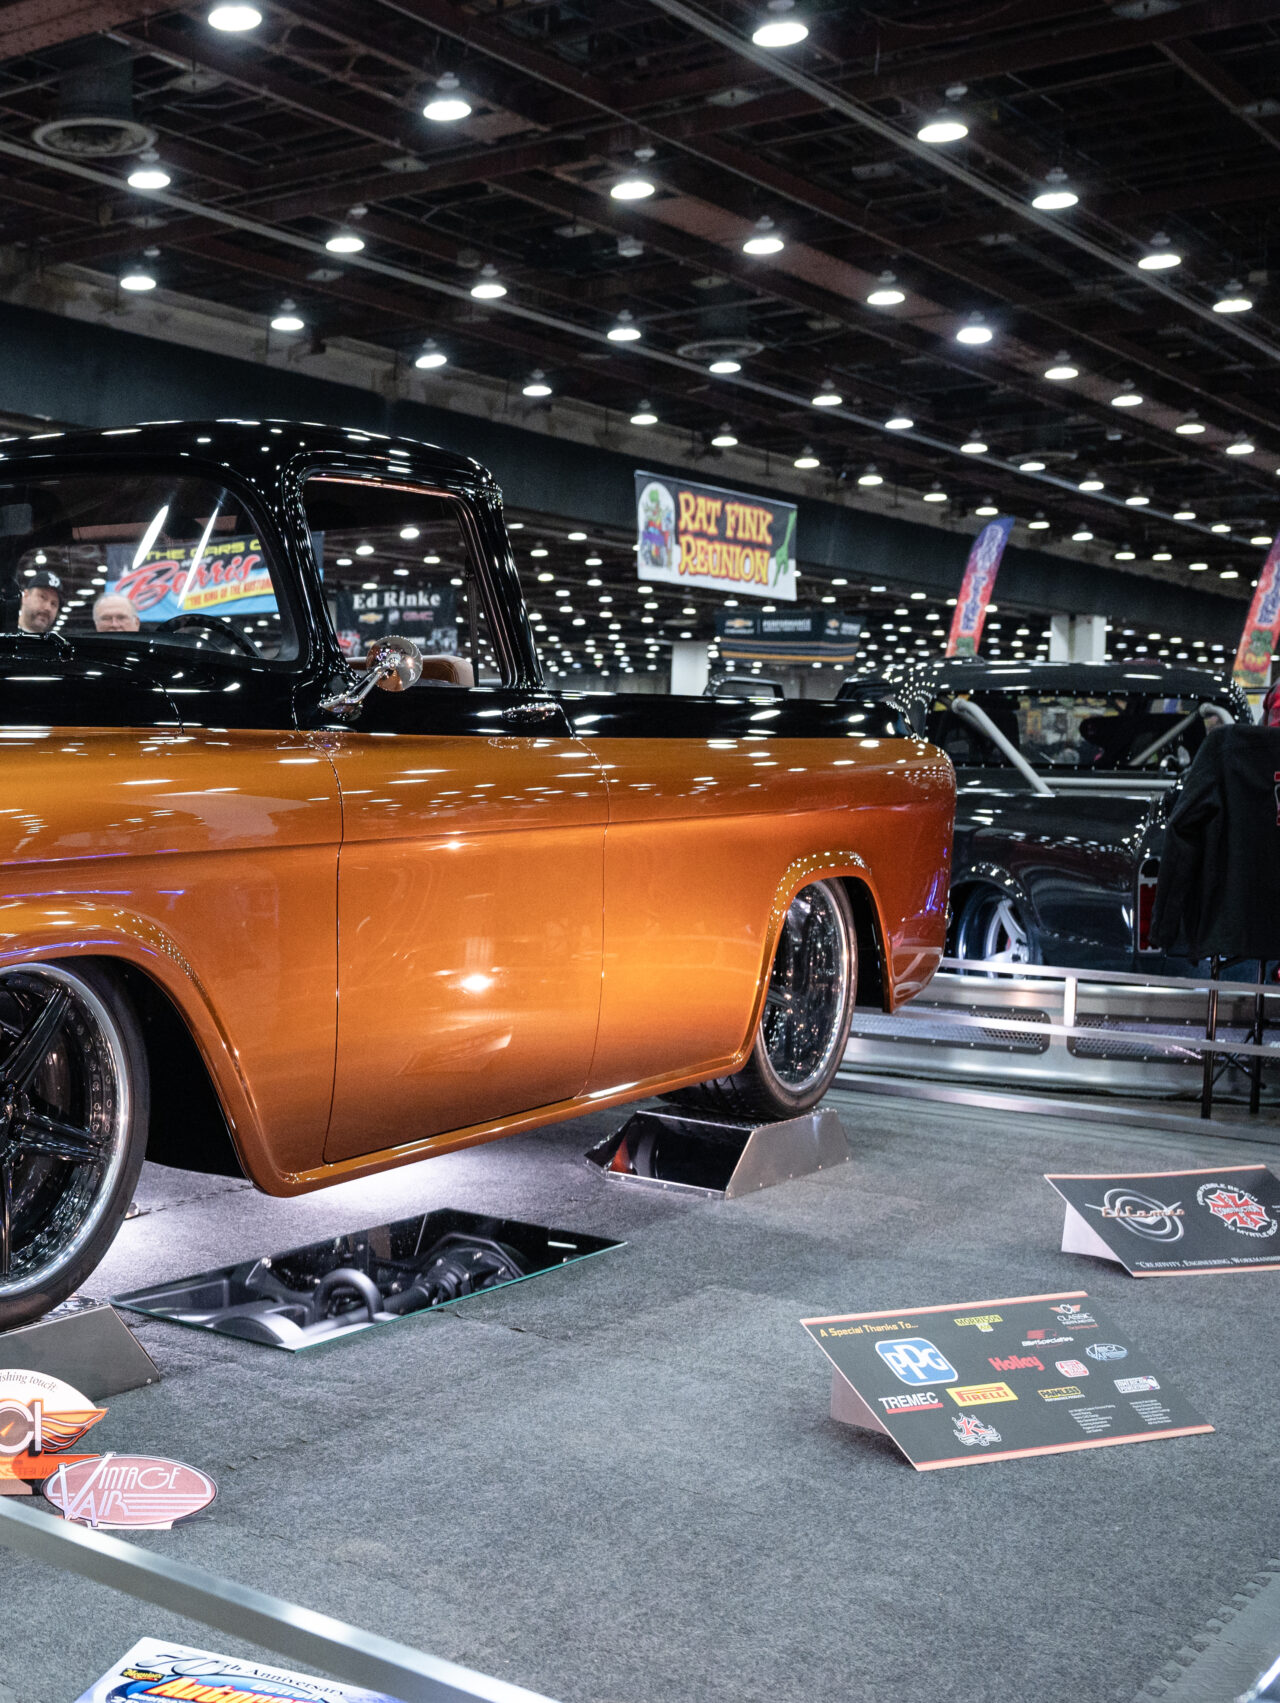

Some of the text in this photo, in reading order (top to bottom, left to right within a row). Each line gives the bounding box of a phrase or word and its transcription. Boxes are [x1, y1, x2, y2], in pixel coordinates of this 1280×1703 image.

[678, 491, 773, 545] RAT FINK
[678, 533, 770, 585] REUNION
[353, 591, 441, 610] Ed Rinke
[820, 1329, 828, 1337] A
[828, 1326, 864, 1337] Special
[863, 1324, 899, 1333] Thanks
[956, 1315, 1002, 1326] MORRISON
[884, 1345, 949, 1379] PPG
[987, 1354, 1045, 1371] Holley
[878, 1392, 939, 1409] TREMEC
[954, 1386, 1010, 1403] PIRELLI
[58, 1451, 182, 1519] VINTAGE
[77, 1490, 129, 1527] AIR
[248, 1668, 345, 1696] Anniversary
